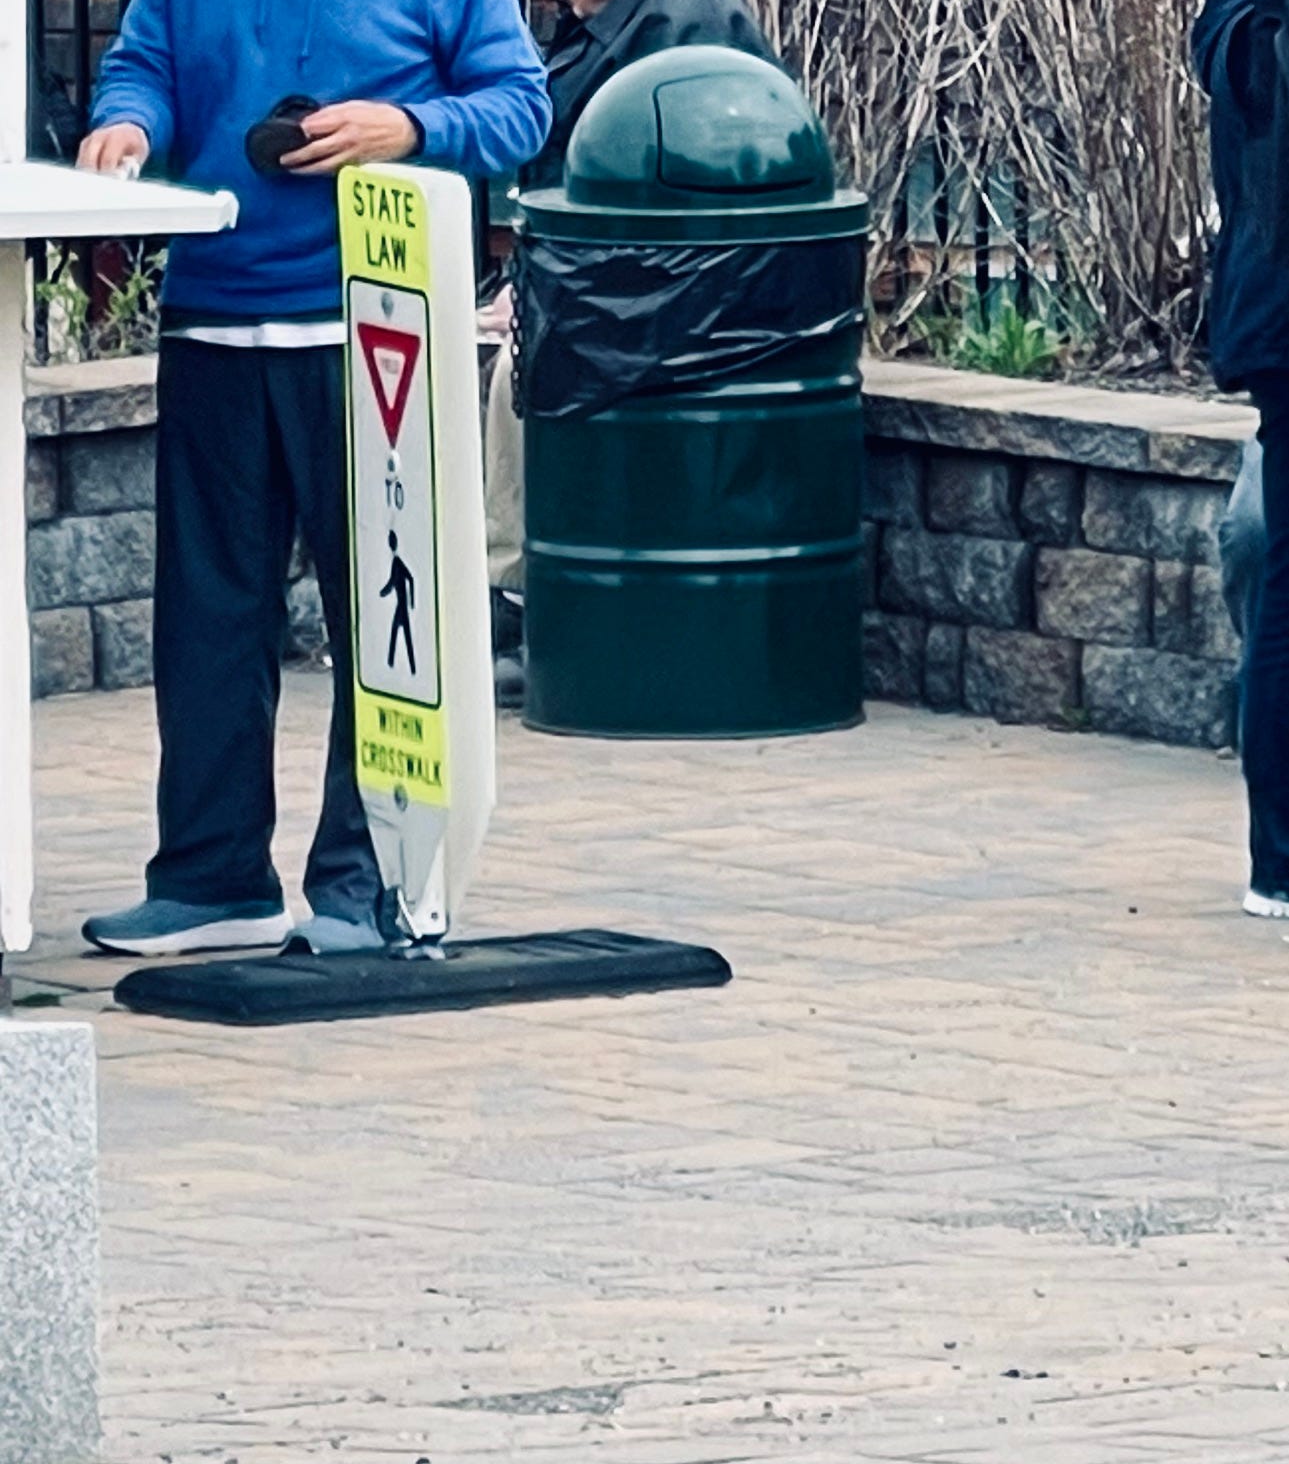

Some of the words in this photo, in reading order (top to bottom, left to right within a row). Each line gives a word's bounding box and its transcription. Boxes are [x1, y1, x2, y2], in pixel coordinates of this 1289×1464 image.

[352, 179, 417, 229] STATE
[365, 229, 407, 274] LAW
[385, 477, 404, 511] TO
[361, 738, 443, 788] CROSSWALK
